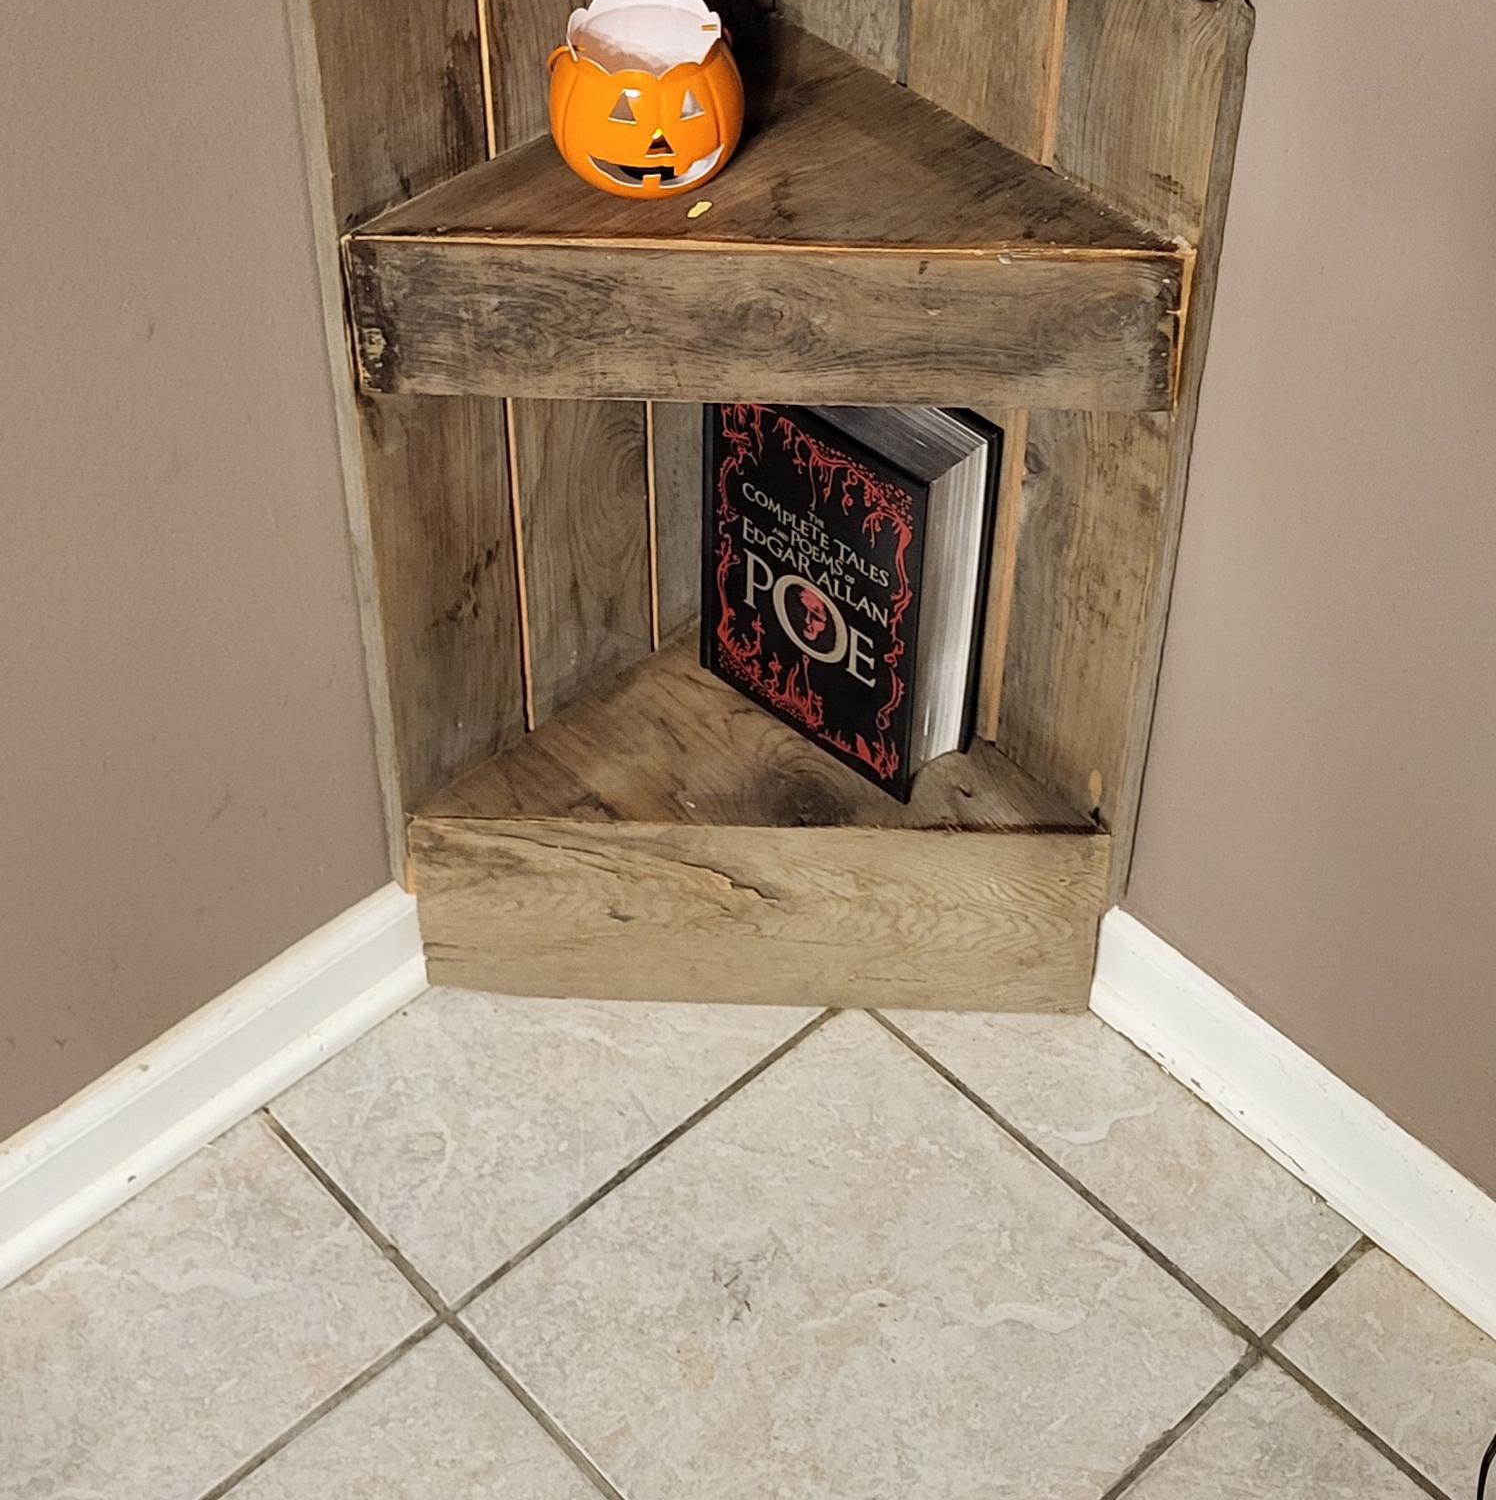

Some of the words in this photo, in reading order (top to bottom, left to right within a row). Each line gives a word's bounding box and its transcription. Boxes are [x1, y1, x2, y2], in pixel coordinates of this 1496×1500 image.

[742, 482, 830, 550] COMPLETE
[834, 538, 890, 588] TALES
[742, 515, 814, 584] EDGAR
[817, 571, 889, 629] ALLAN
[791, 533, 843, 576] POEMS
[844, 574, 855, 585] OF
[807, 510, 825, 529] THE
[743, 548, 876, 688] POE
